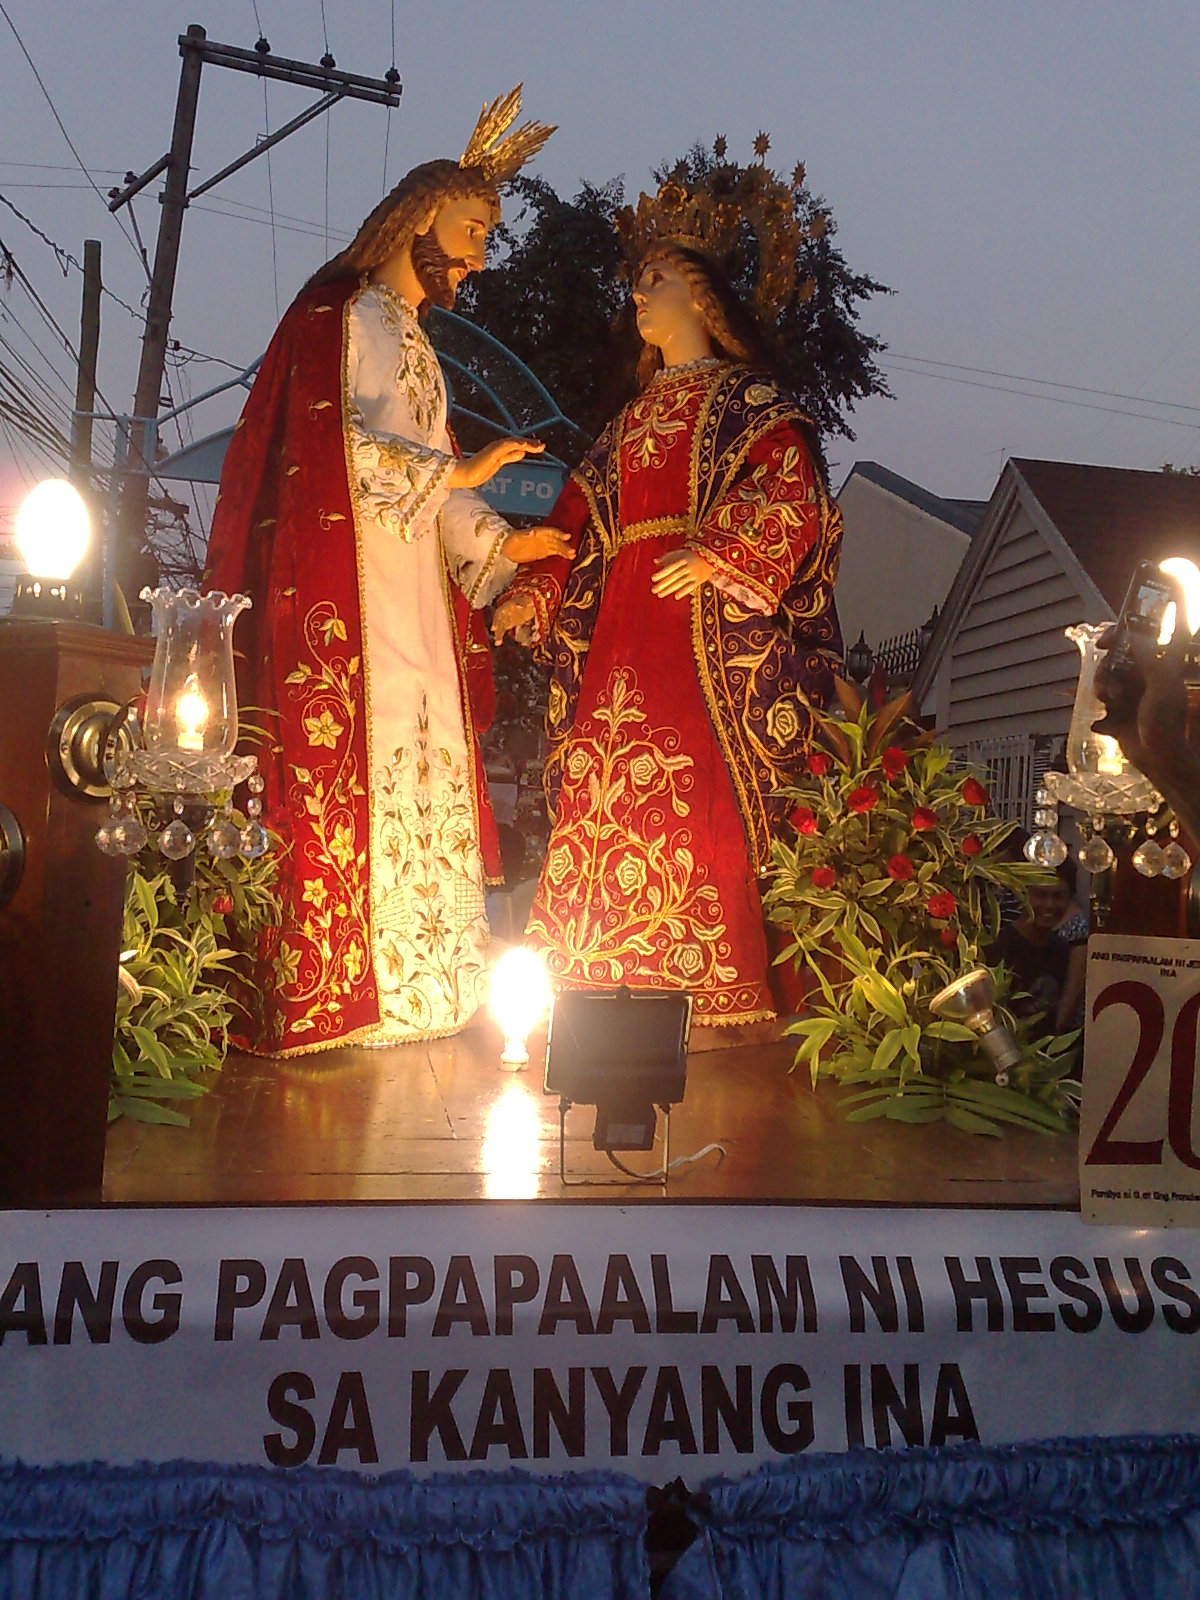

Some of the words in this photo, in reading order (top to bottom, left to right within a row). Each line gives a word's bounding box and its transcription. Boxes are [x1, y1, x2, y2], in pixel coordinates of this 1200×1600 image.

[481, 477, 512, 494] AT
[520, 480, 554, 499] PO
[1160, 968, 1177, 977] INA
[0, 1259, 183, 1346] ANG
[214, 1254, 820, 1342] PAGPAPAALAM
[839, 1256, 925, 1339] NI
[944, 1256, 1200, 1334] HESUS
[263, 1371, 379, 1467] SA
[410, 1363, 816, 1462] KANYANG
[844, 1363, 980, 1452] INA
